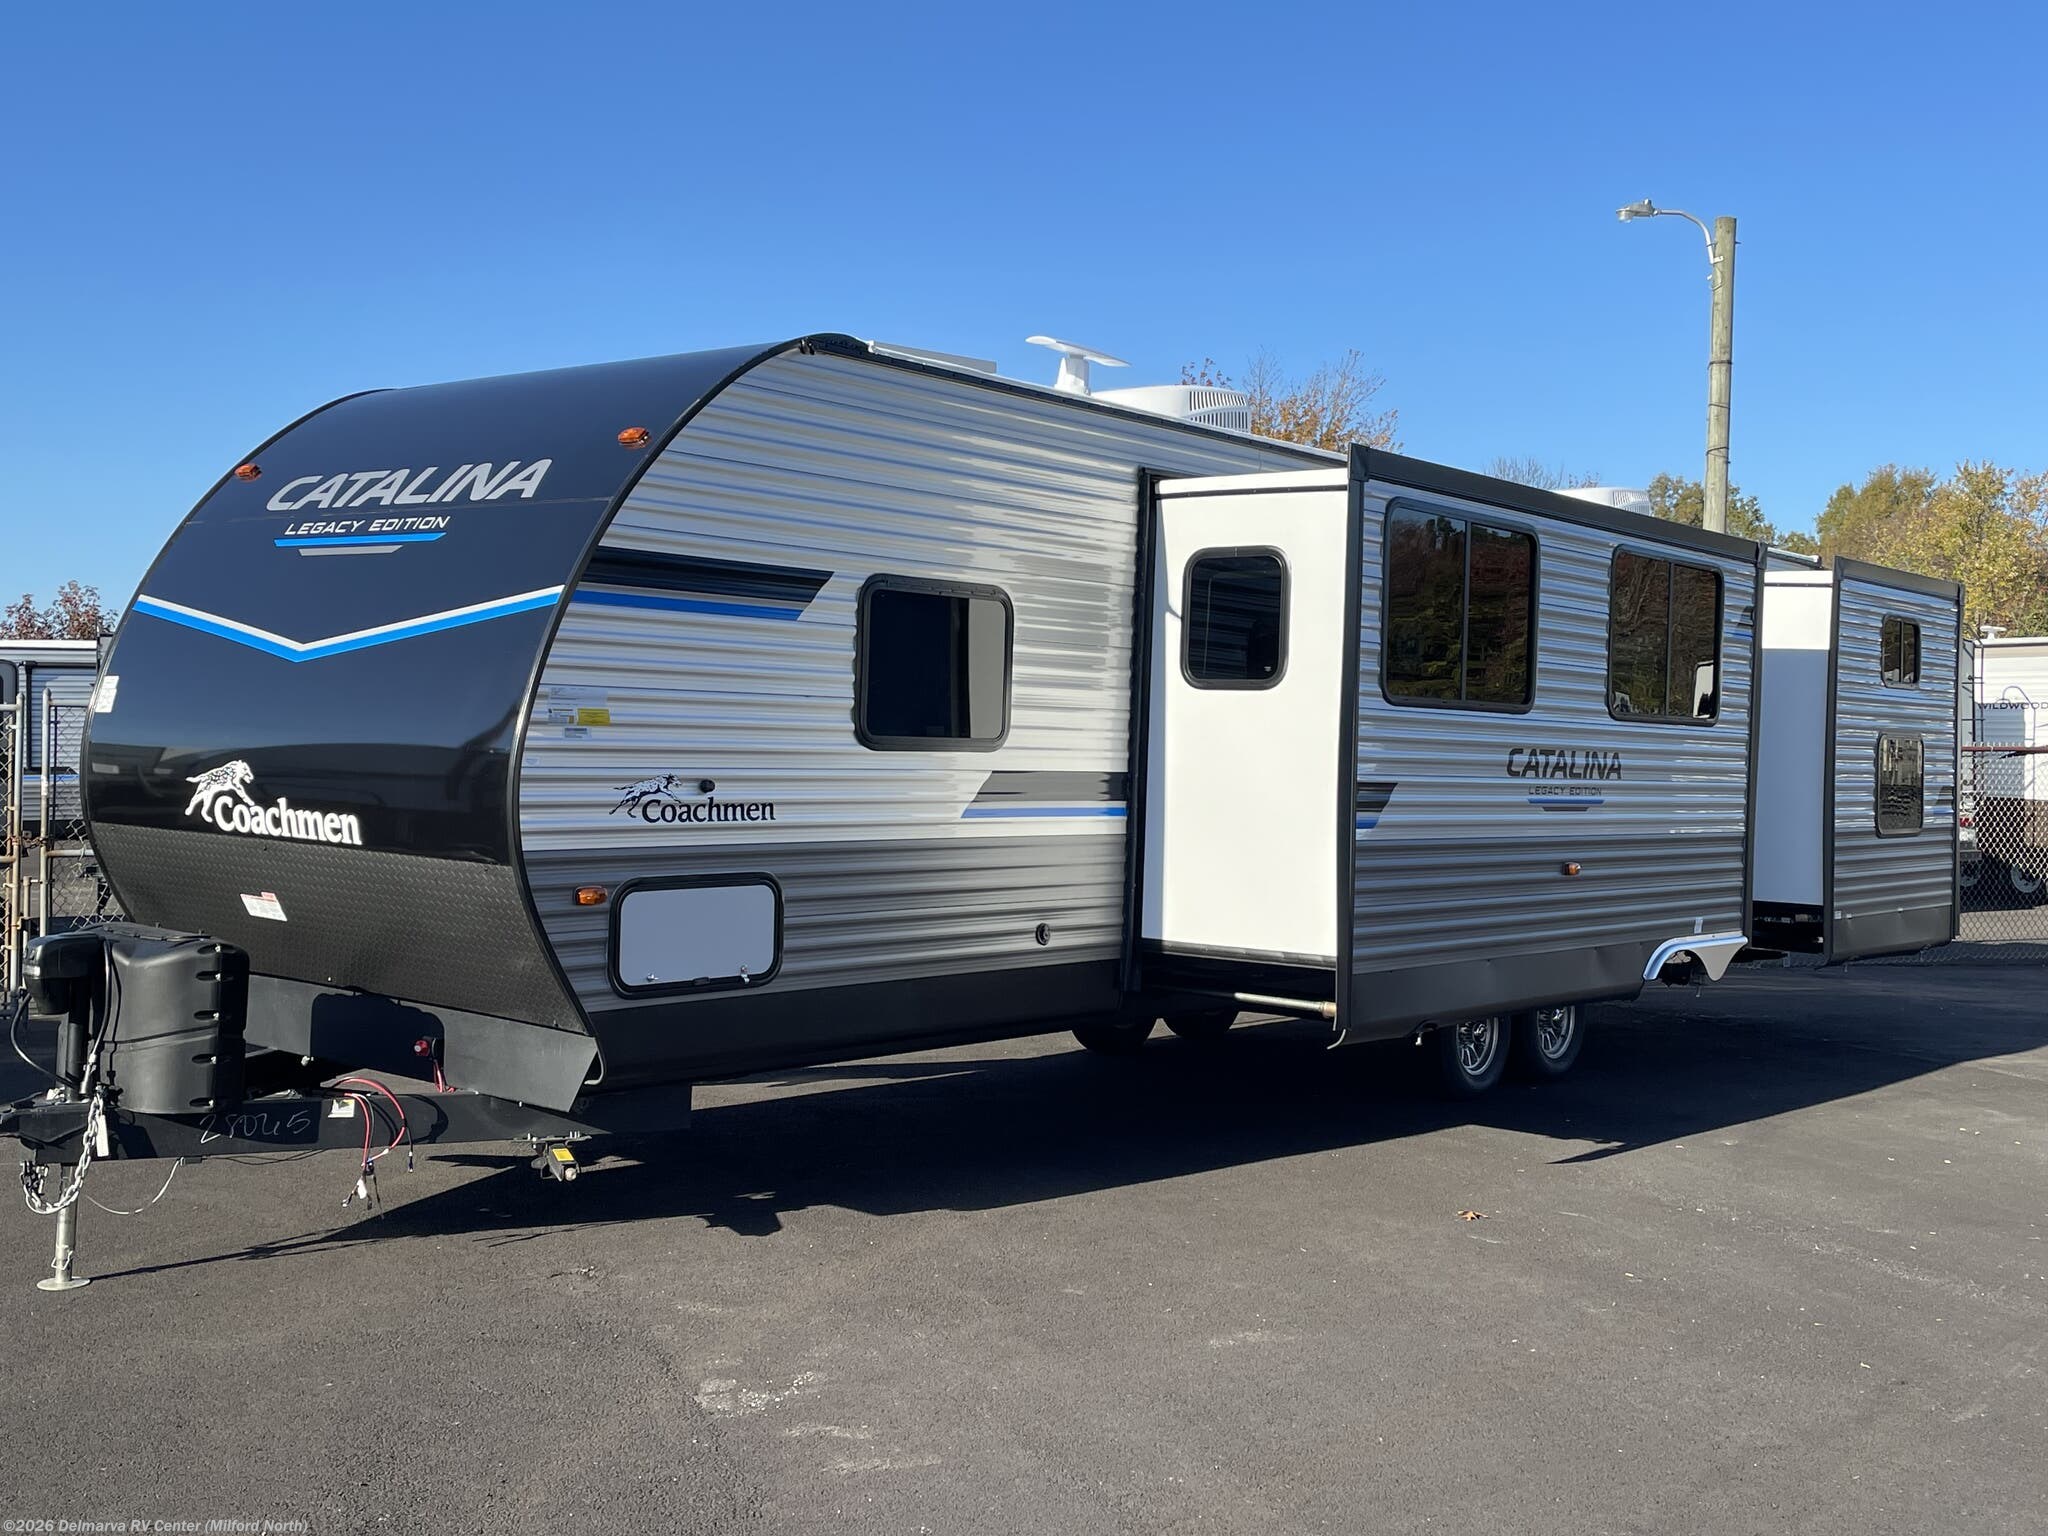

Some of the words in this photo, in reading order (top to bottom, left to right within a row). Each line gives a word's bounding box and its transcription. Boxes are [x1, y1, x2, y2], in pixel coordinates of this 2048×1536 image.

[266, 458, 552, 511] CATALINA
[284, 519, 365, 535] LEGACY
[368, 515, 450, 532] EDITION
[1507, 748, 1622, 779] CATALINA
[1529, 786, 1566, 795] LEGACY
[214, 796, 363, 846] Coachmen
[642, 796, 776, 823] Coachmen
